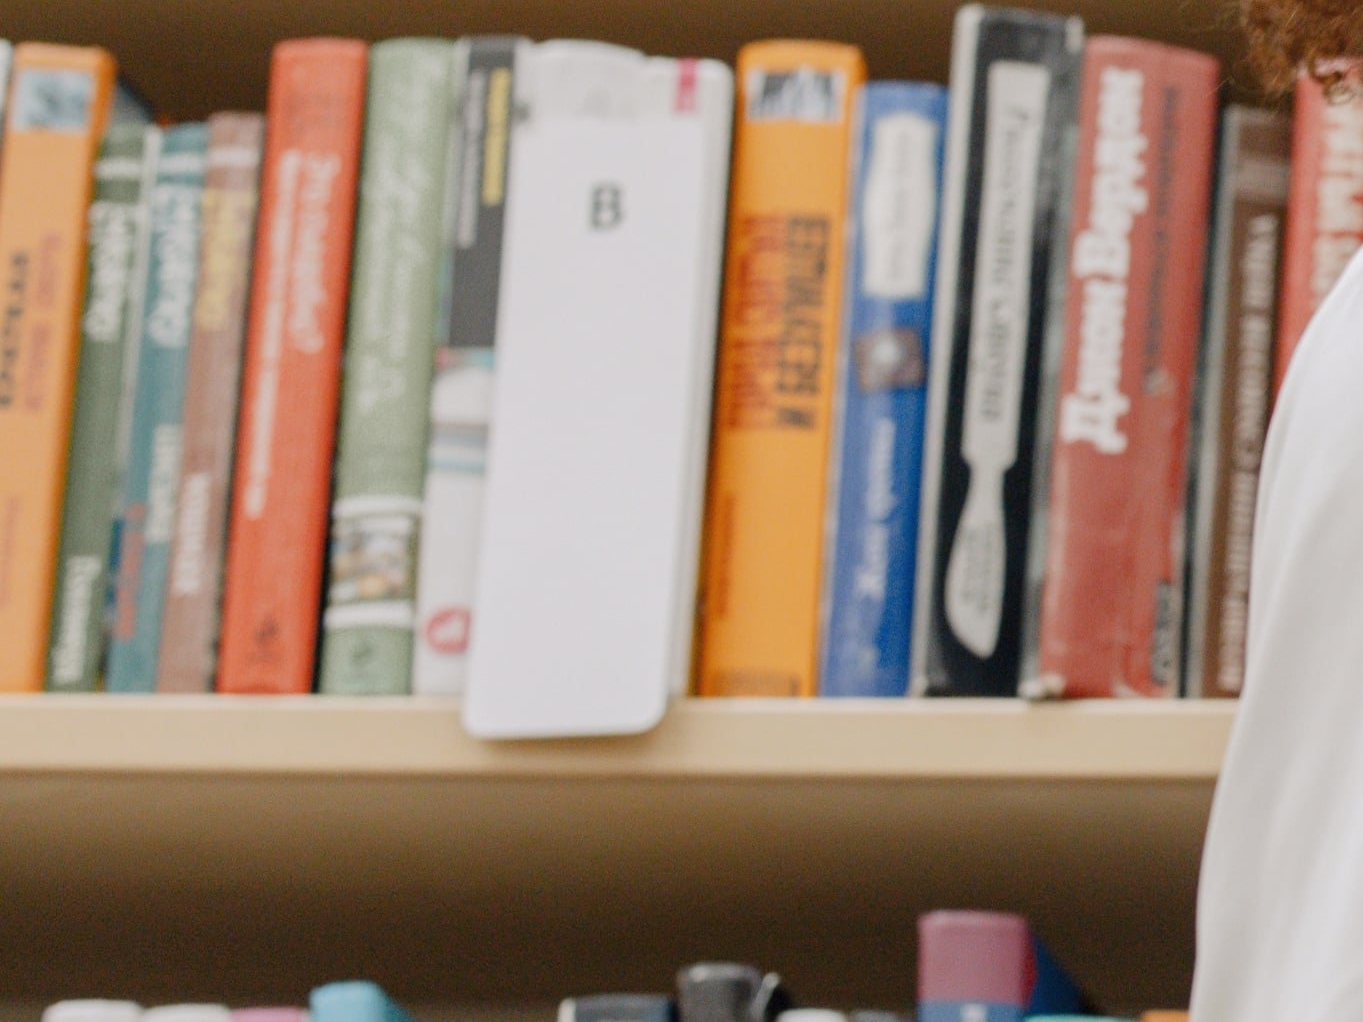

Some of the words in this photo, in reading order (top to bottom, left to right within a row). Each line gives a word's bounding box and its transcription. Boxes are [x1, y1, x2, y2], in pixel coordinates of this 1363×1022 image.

[588, 184, 625, 232] В
[1073, 66, 1150, 276] Вердон
[1062, 277, 1131, 454] Джон
